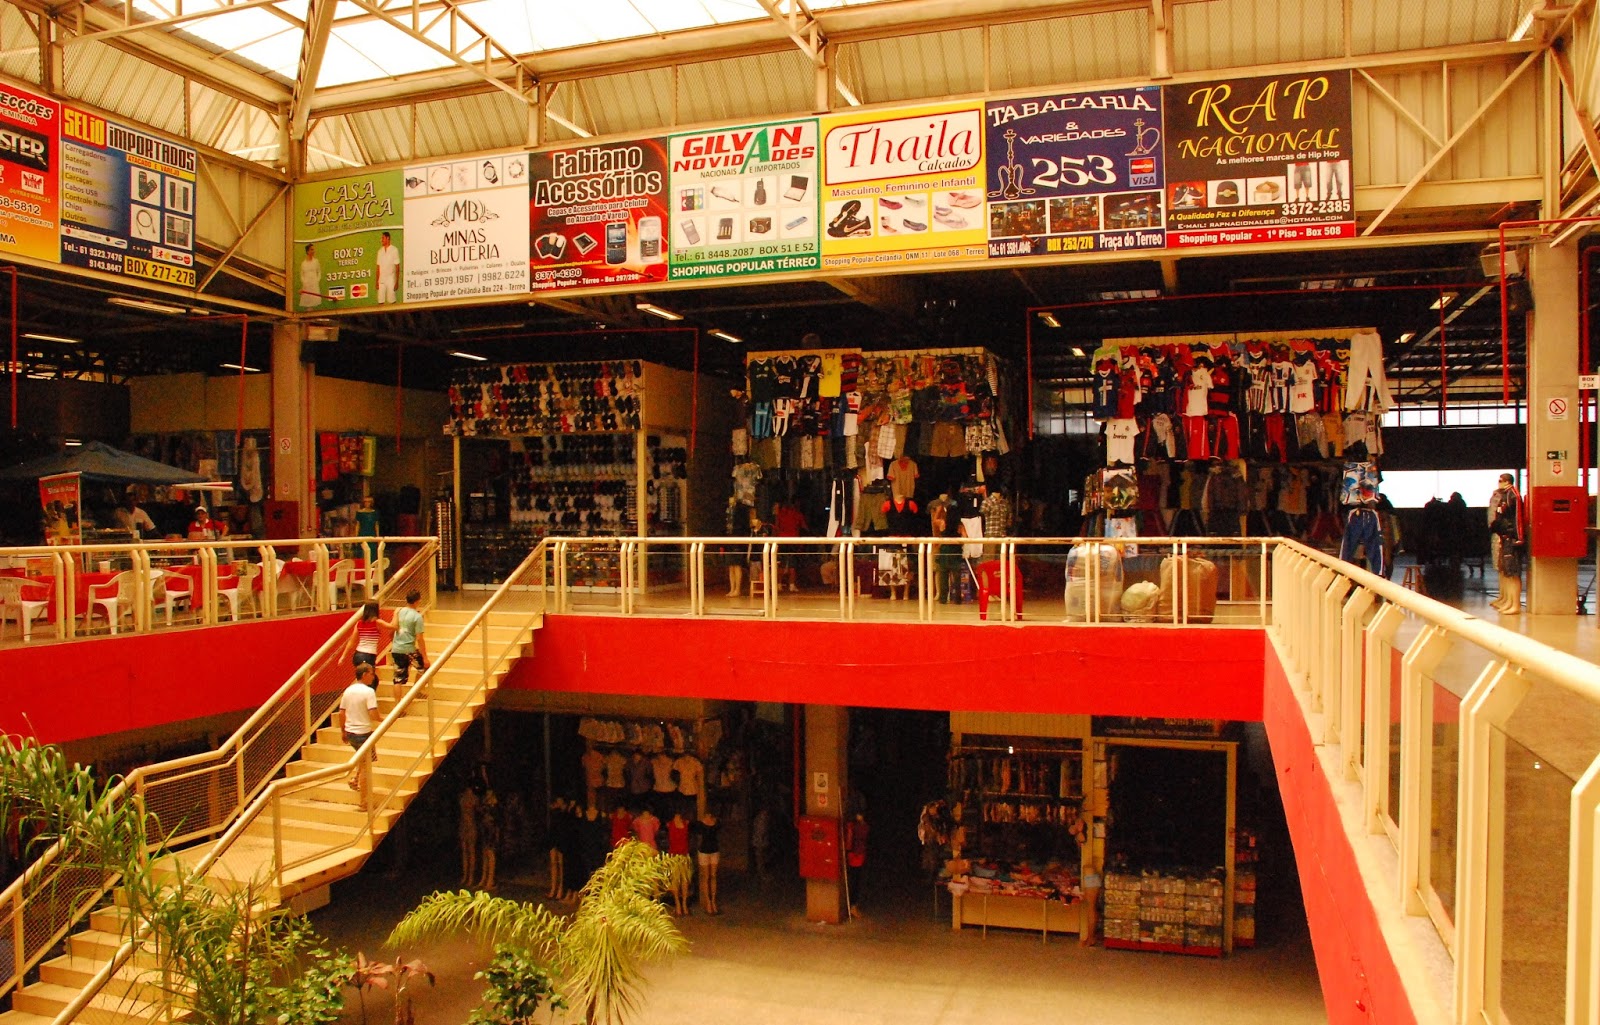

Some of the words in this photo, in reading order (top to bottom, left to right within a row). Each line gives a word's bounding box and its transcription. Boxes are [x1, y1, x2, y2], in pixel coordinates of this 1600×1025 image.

[987, 94, 1157, 127] TABACARIA
[1188, 77, 1329, 135] RAP
[1065, 121, 1078, 131] &
[682, 126, 803, 162] GILVAN
[839, 120, 974, 169] Thaila
[1020, 128, 1127, 145] VARIEDADES
[1178, 128, 1340, 159] NACIONAL
[65, 143, 107, 162] Carregadores
[1228, 156, 1265, 164] melhores
[1266, 153, 1295, 161] marcas
[1308, 151, 1322, 159] Hip
[1323, 150, 1340, 158] Hop
[65, 163, 89, 175] Frentes
[553, 147, 643, 179] Fabiano
[700, 168, 737, 179] NACIONAIS
[754, 162, 801, 173] IMPORTADOS
[918, 157, 972, 172] Calçados
[1031, 154, 1117, 188] 253
[535, 171, 662, 207] Acessórios
[832, 187, 883, 198] Masculino,
[885, 183, 930, 193] Feminino
[941, 177, 976, 187] Infantil
[1132, 176, 1155, 185] VISA
[322, 181, 376, 204] CASA
[65, 201, 82, 212] Chips
[305, 198, 394, 226] BRANCA
[451, 199, 479, 222] MB
[548, 207, 570, 217] Capas
[572, 203, 608, 214] Acessórios
[608, 201, 623, 211] para
[624, 198, 648, 208] Celular
[1176, 212, 1215, 220] Qualidade
[1238, 209, 1275, 217] Diferença
[1282, 200, 1351, 216] 3372-2385
[575, 213, 601, 223] Atacado
[606, 210, 629, 220] Varejo
[443, 228, 487, 247] MINAS
[1099, 233, 1123, 251] Praça
[1124, 233, 1134, 246] do
[1135, 232, 1163, 246] Terreo
[1179, 233, 1218, 244] Shopping
[1219, 231, 1253, 242] Popular
[1278, 229, 1297, 238] Piso
[1306, 227, 1322, 237] Box
[1324, 226, 1341, 235] 508
[333, 249, 352, 260] BOX
[353, 247, 364, 258] 79
[430, 244, 500, 265] BIJUTERIA
[694, 252, 706, 261] 61
[708, 247, 755, 260] 8448.2087
[759, 245, 779, 255] BOX
[781, 244, 792, 253] 51
[794, 244, 800, 252] E
[802, 242, 814, 251] 52
[824, 257, 850, 266] Shopping
[851, 256, 874, 264] Popular
[126, 258, 149, 276] BOX
[151, 264, 195, 285] 277-278
[326, 269, 371, 281] 3373-7361
[535, 268, 582, 281] 3371-4390
[672, 264, 724, 278] SHOPPING
[726, 259, 775, 273] POPULAR
[776, 256, 817, 269] TÉRREO
[406, 292, 429, 300] Shopping
[430, 289, 449, 298] Popular
[450, 288, 456, 296] de
[482, 285, 491, 293] Box
[493, 284, 503, 292] 224
[424, 278, 432, 287] 61
[557, 279, 577, 287] Popular
